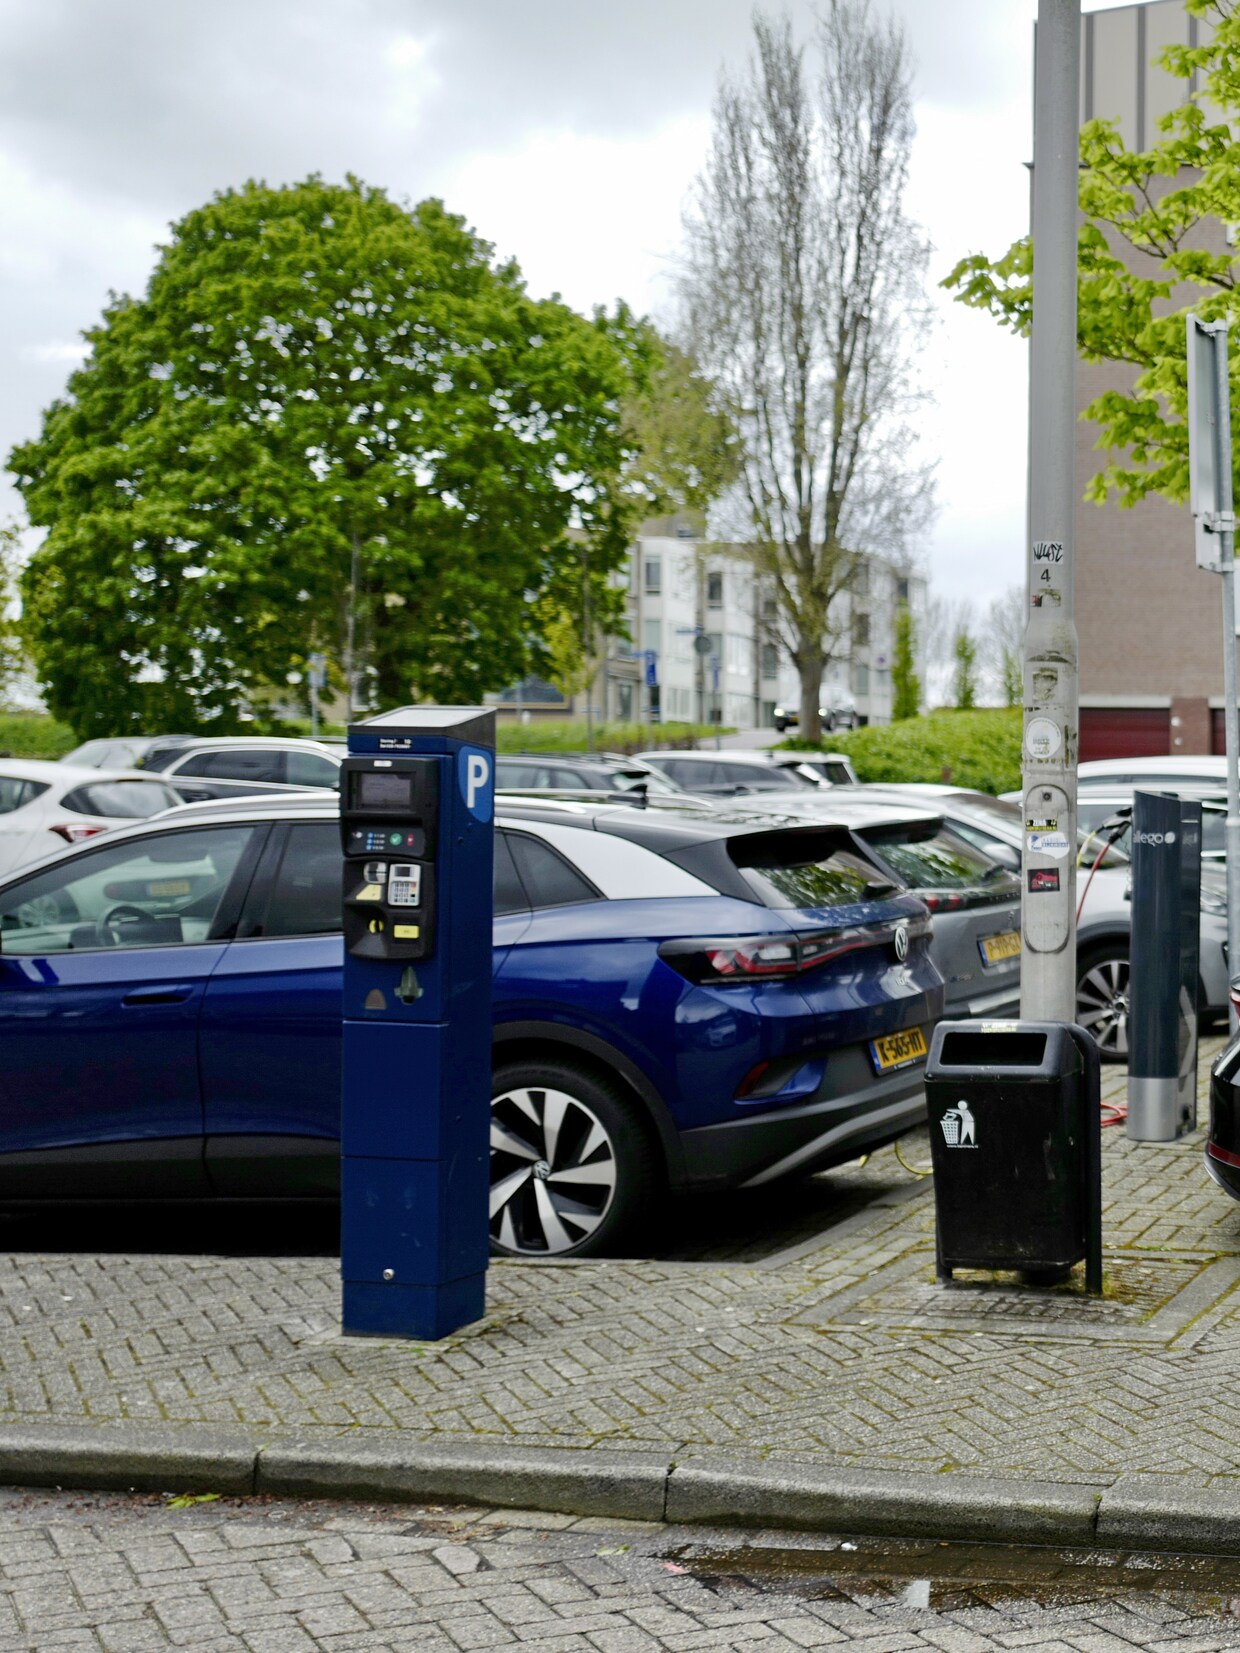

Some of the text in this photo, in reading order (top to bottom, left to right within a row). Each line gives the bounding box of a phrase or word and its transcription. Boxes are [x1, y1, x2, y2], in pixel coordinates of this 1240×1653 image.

[1040, 568, 1051, 582] 4
[467, 754, 489, 809] P
[877, 1031, 922, 1063] K-565-HT
